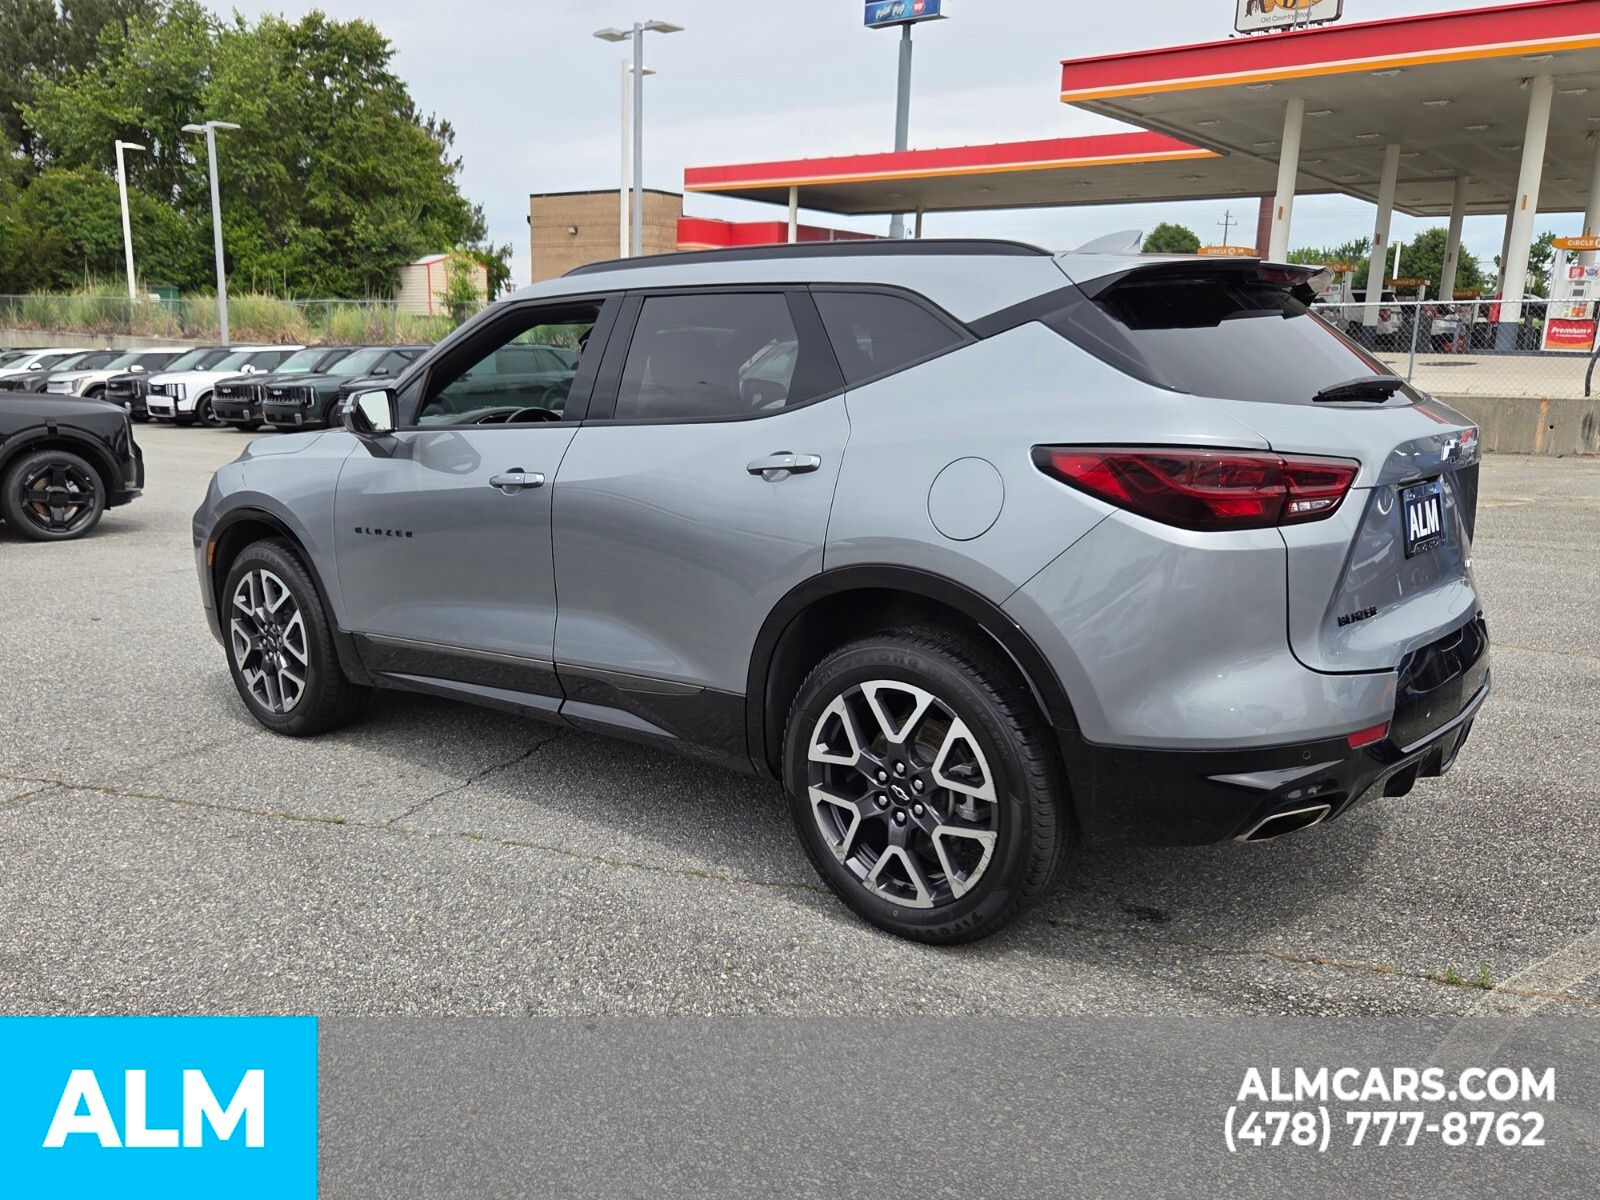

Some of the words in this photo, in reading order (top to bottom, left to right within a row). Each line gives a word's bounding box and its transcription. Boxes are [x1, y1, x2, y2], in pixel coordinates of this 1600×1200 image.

[1272, 13, 1295, 21] Country
[1409, 497, 1440, 541] ALM
[354, 526, 414, 539] BLAZER
